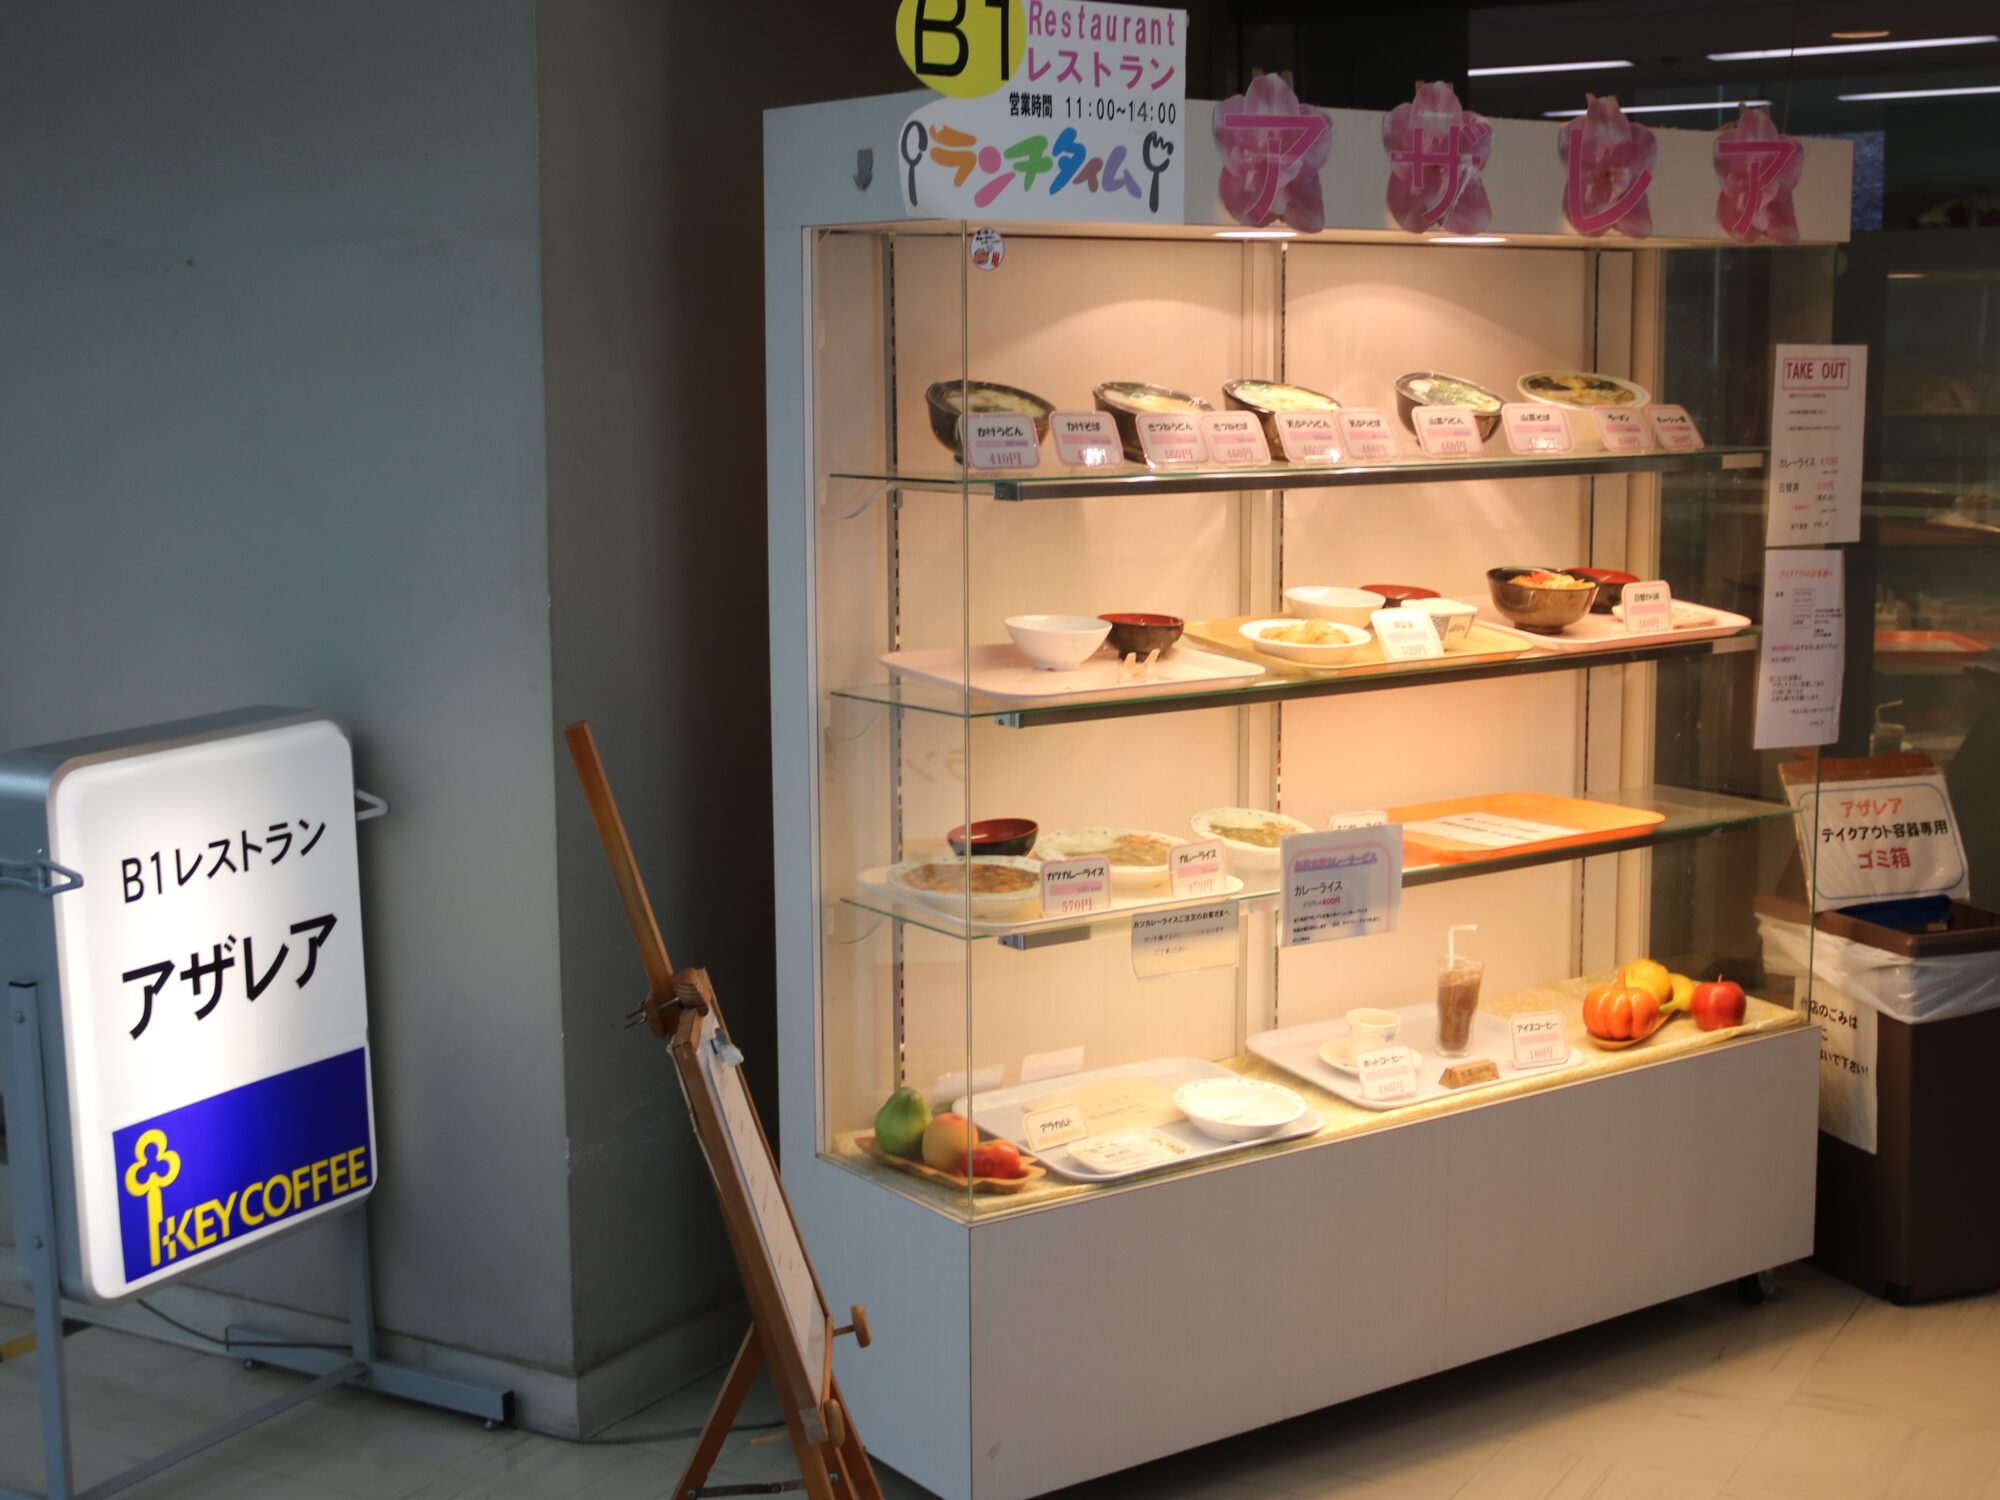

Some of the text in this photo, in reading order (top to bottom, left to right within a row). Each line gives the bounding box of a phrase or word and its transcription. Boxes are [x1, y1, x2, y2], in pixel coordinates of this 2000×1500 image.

[1028, 0, 1175, 46] Restaurant
[914, 0, 1009, 81] B1
[1027, 47, 1175, 91] レストラン
[1008, 91, 1053, 118] 営業時間
[929, 122, 1142, 208] ランチタイム
[1786, 362, 1846, 380] TAKE OUT
[1840, 796, 1904, 819] アザレア
[1821, 819, 1949, 844] テイクアウト容器専用
[120, 818, 326, 904] B1レストラン
[1178, 849, 1217, 865] カレーライス
[1857, 846, 1911, 870] ゴミ箱
[1294, 880, 1343, 897] カレーライス
[1061, 898, 1093, 913] 570円
[121, 912, 338, 1041] アザレア
[1516, 1020, 1559, 1034] アイスコーヒー
[1363, 1055, 1405, 1068] ホットコーヒー
[163, 1146, 368, 1261] KEY COFFEE
